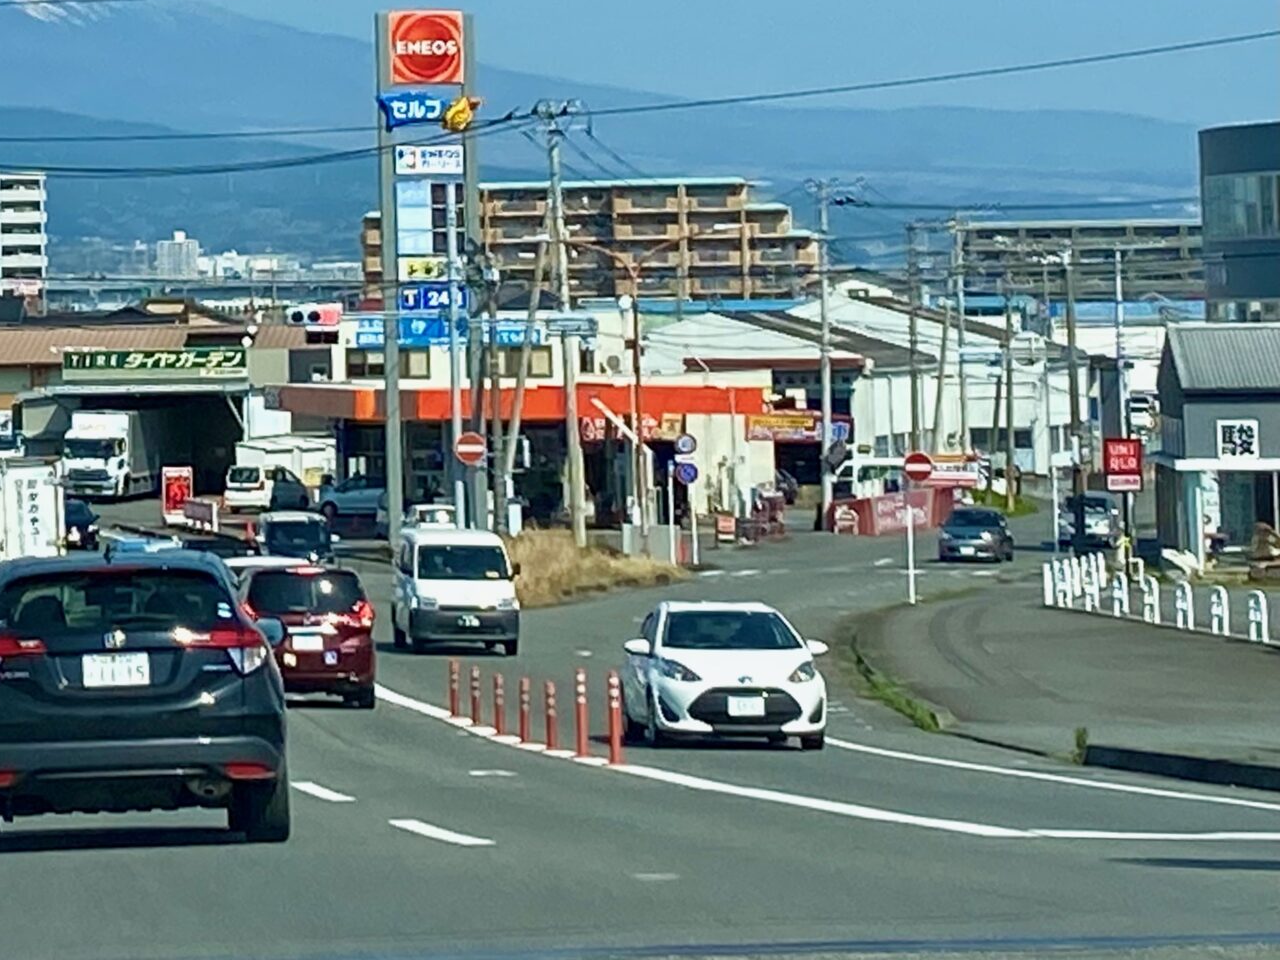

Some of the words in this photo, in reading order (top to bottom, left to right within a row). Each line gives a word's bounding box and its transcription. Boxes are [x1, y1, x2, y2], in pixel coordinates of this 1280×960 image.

[396, 39, 458, 56] ENEOS
[390, 99, 442, 119] セルフ
[71, 354, 118, 368] TIRE
[123, 350, 242, 368] タイヤガーデン
